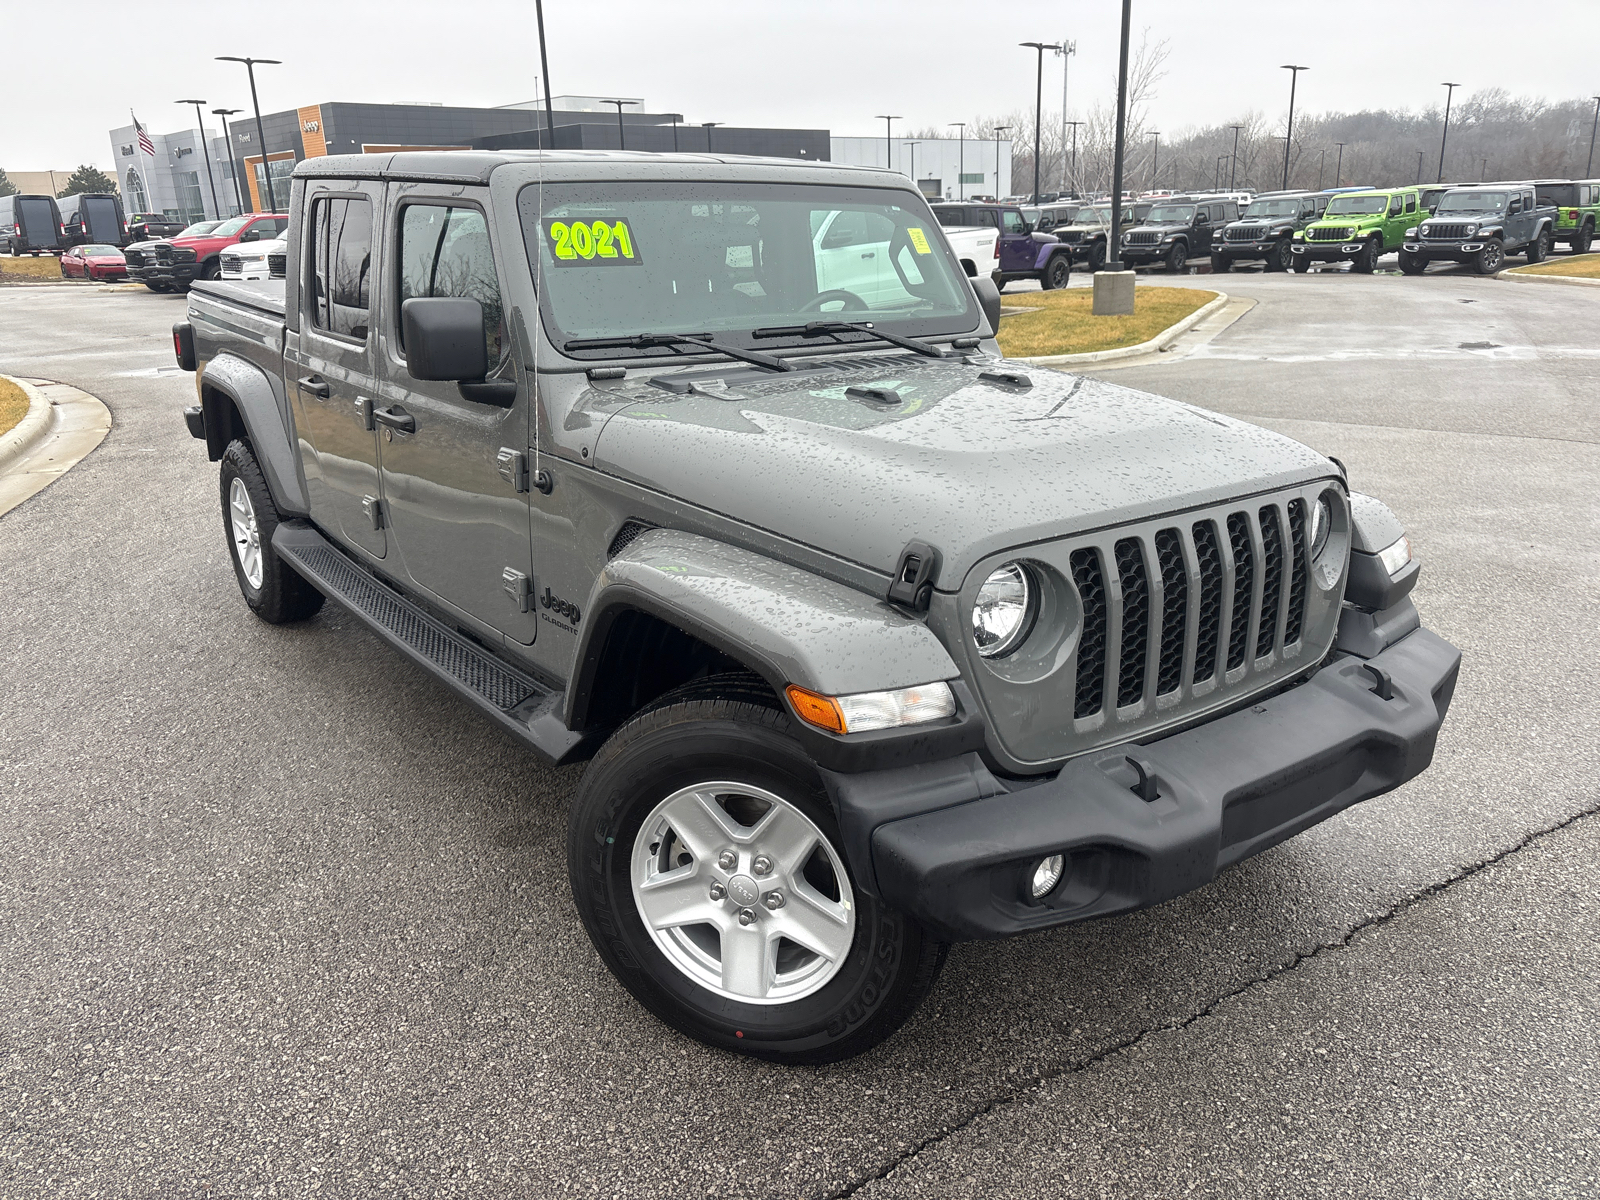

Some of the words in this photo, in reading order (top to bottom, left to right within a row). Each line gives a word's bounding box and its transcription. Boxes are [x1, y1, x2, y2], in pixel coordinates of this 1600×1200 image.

[303, 120, 319, 133] Jeep
[238, 133, 251, 143] Reed
[550, 221, 634, 260] 2021
[540, 586, 581, 625] Jeep
[541, 612, 579, 635] GLADIATO
[732, 882, 754, 901] Jeep
